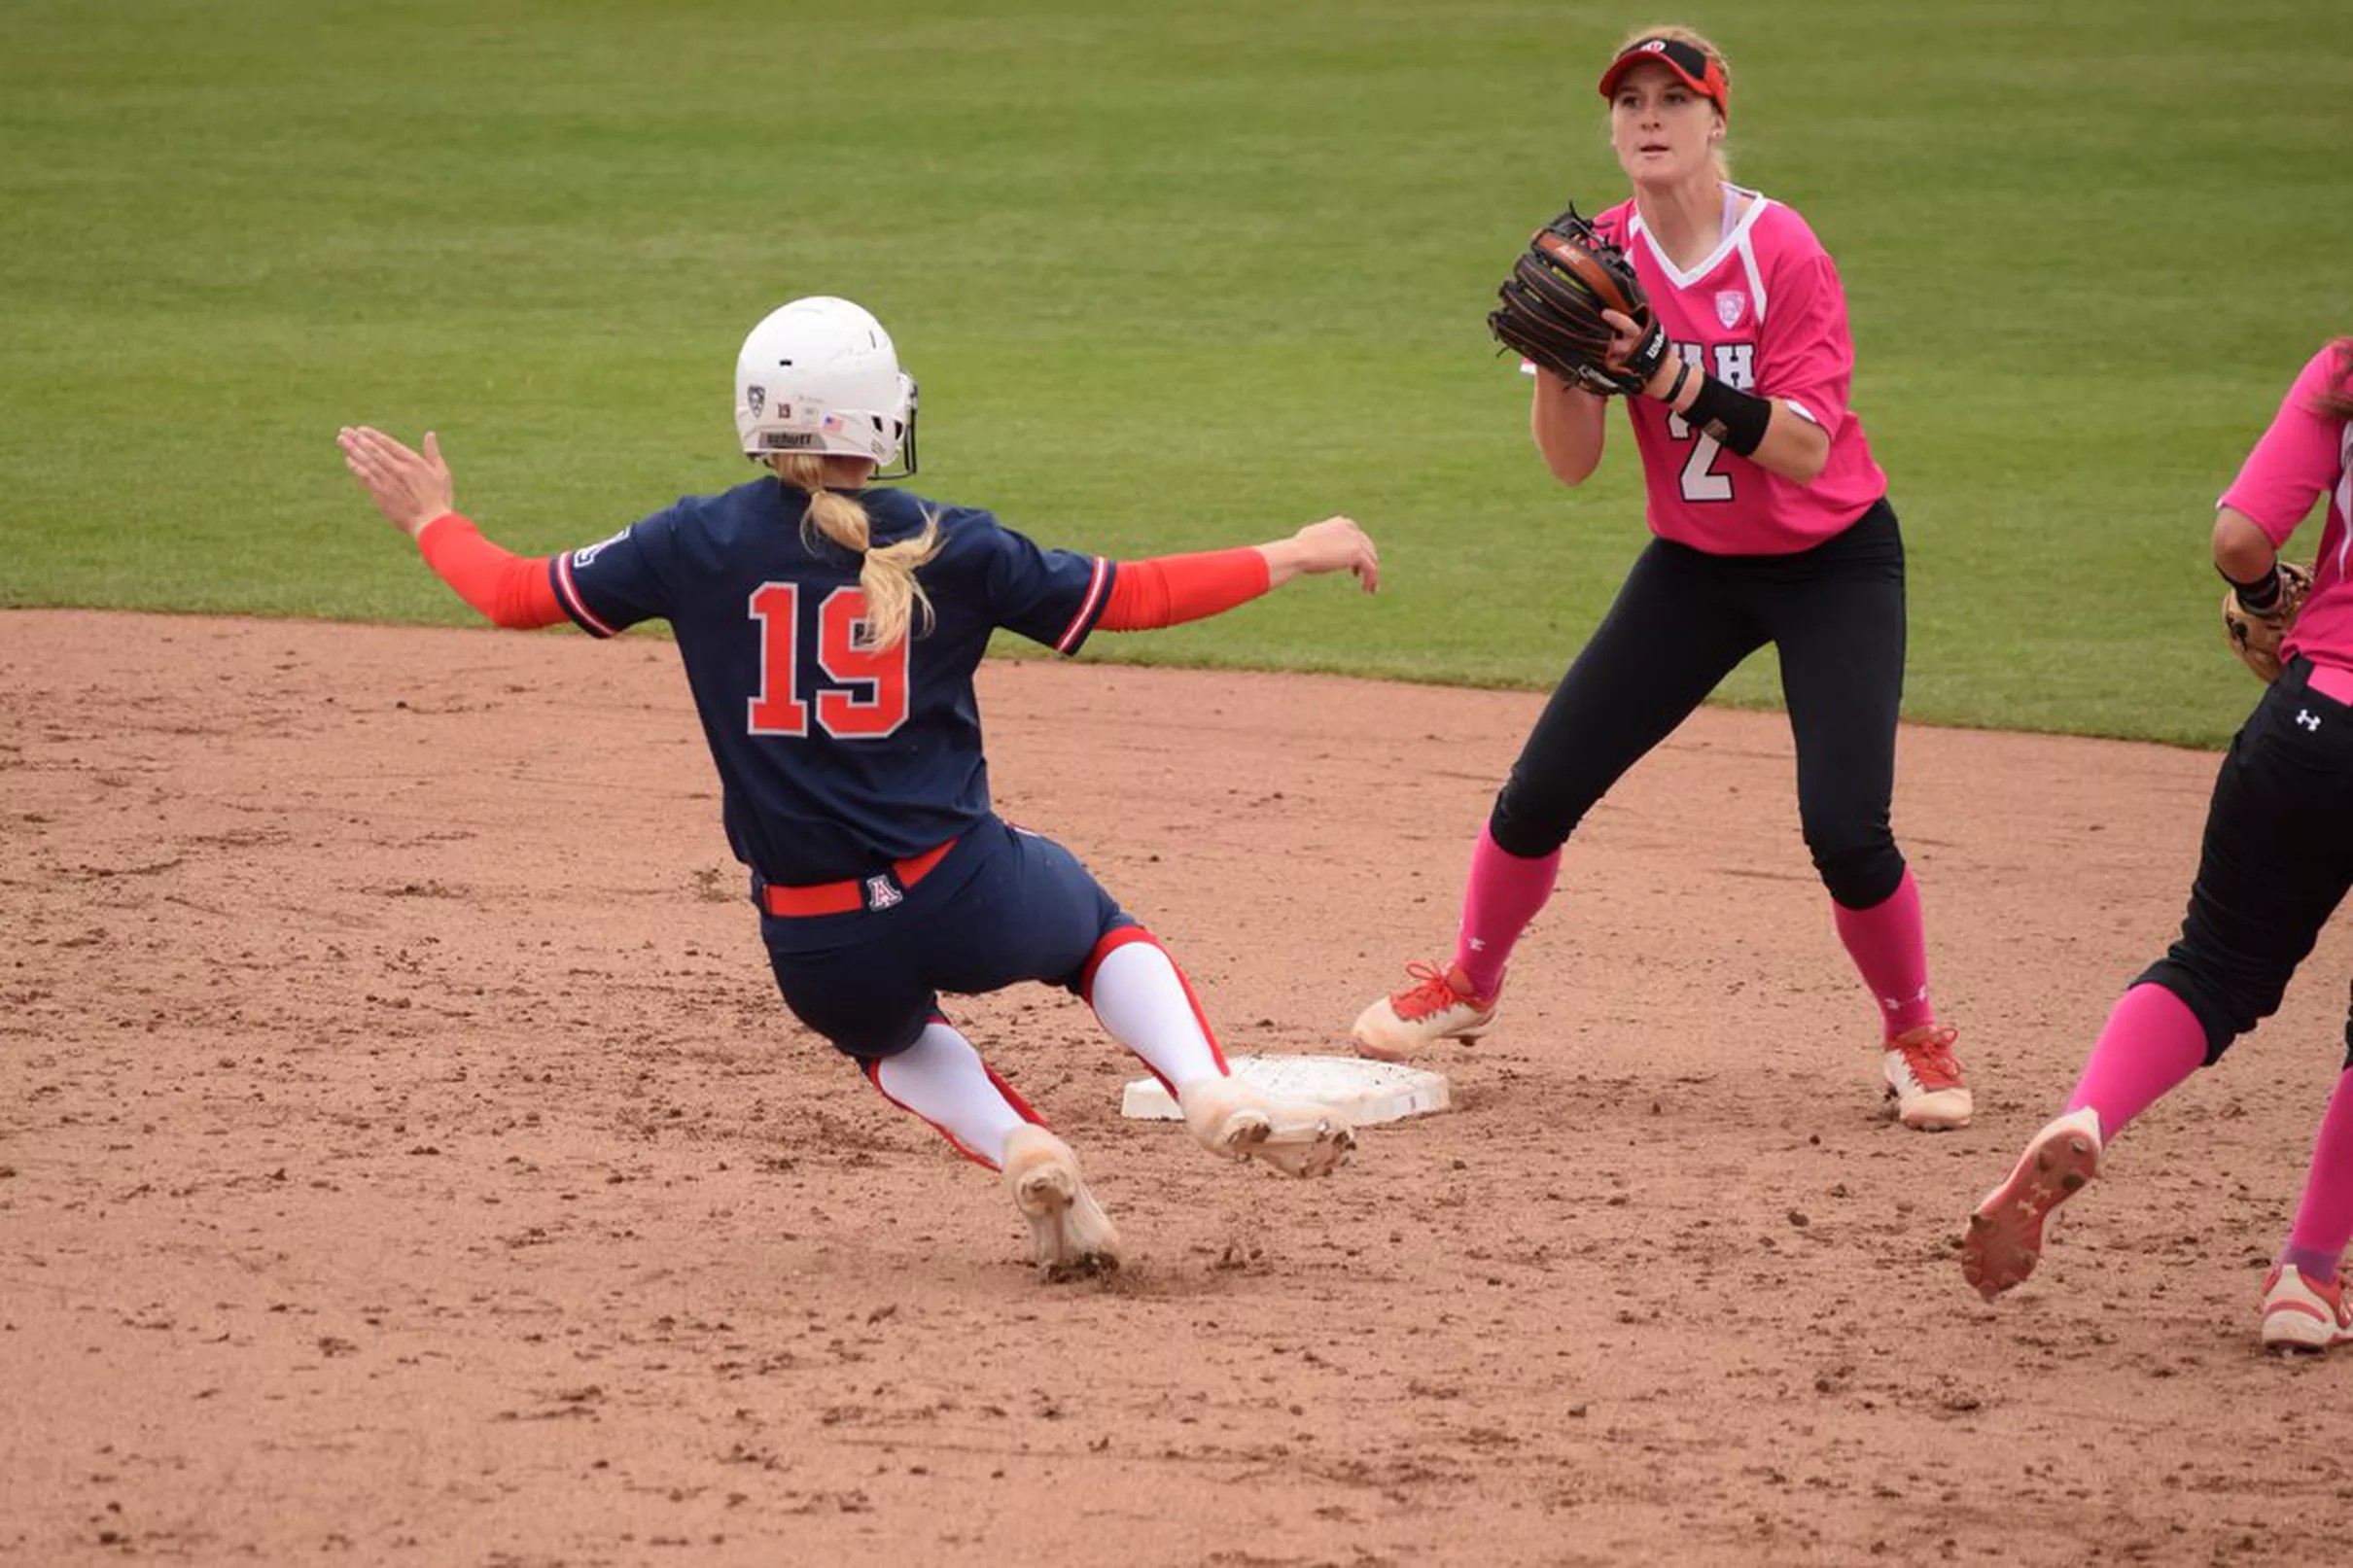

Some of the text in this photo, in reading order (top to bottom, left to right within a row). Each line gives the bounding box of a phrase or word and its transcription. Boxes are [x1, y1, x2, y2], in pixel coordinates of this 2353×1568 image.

[1667, 409, 1735, 502] 2
[748, 581, 912, 739] 19
[866, 875, 903, 912] A
